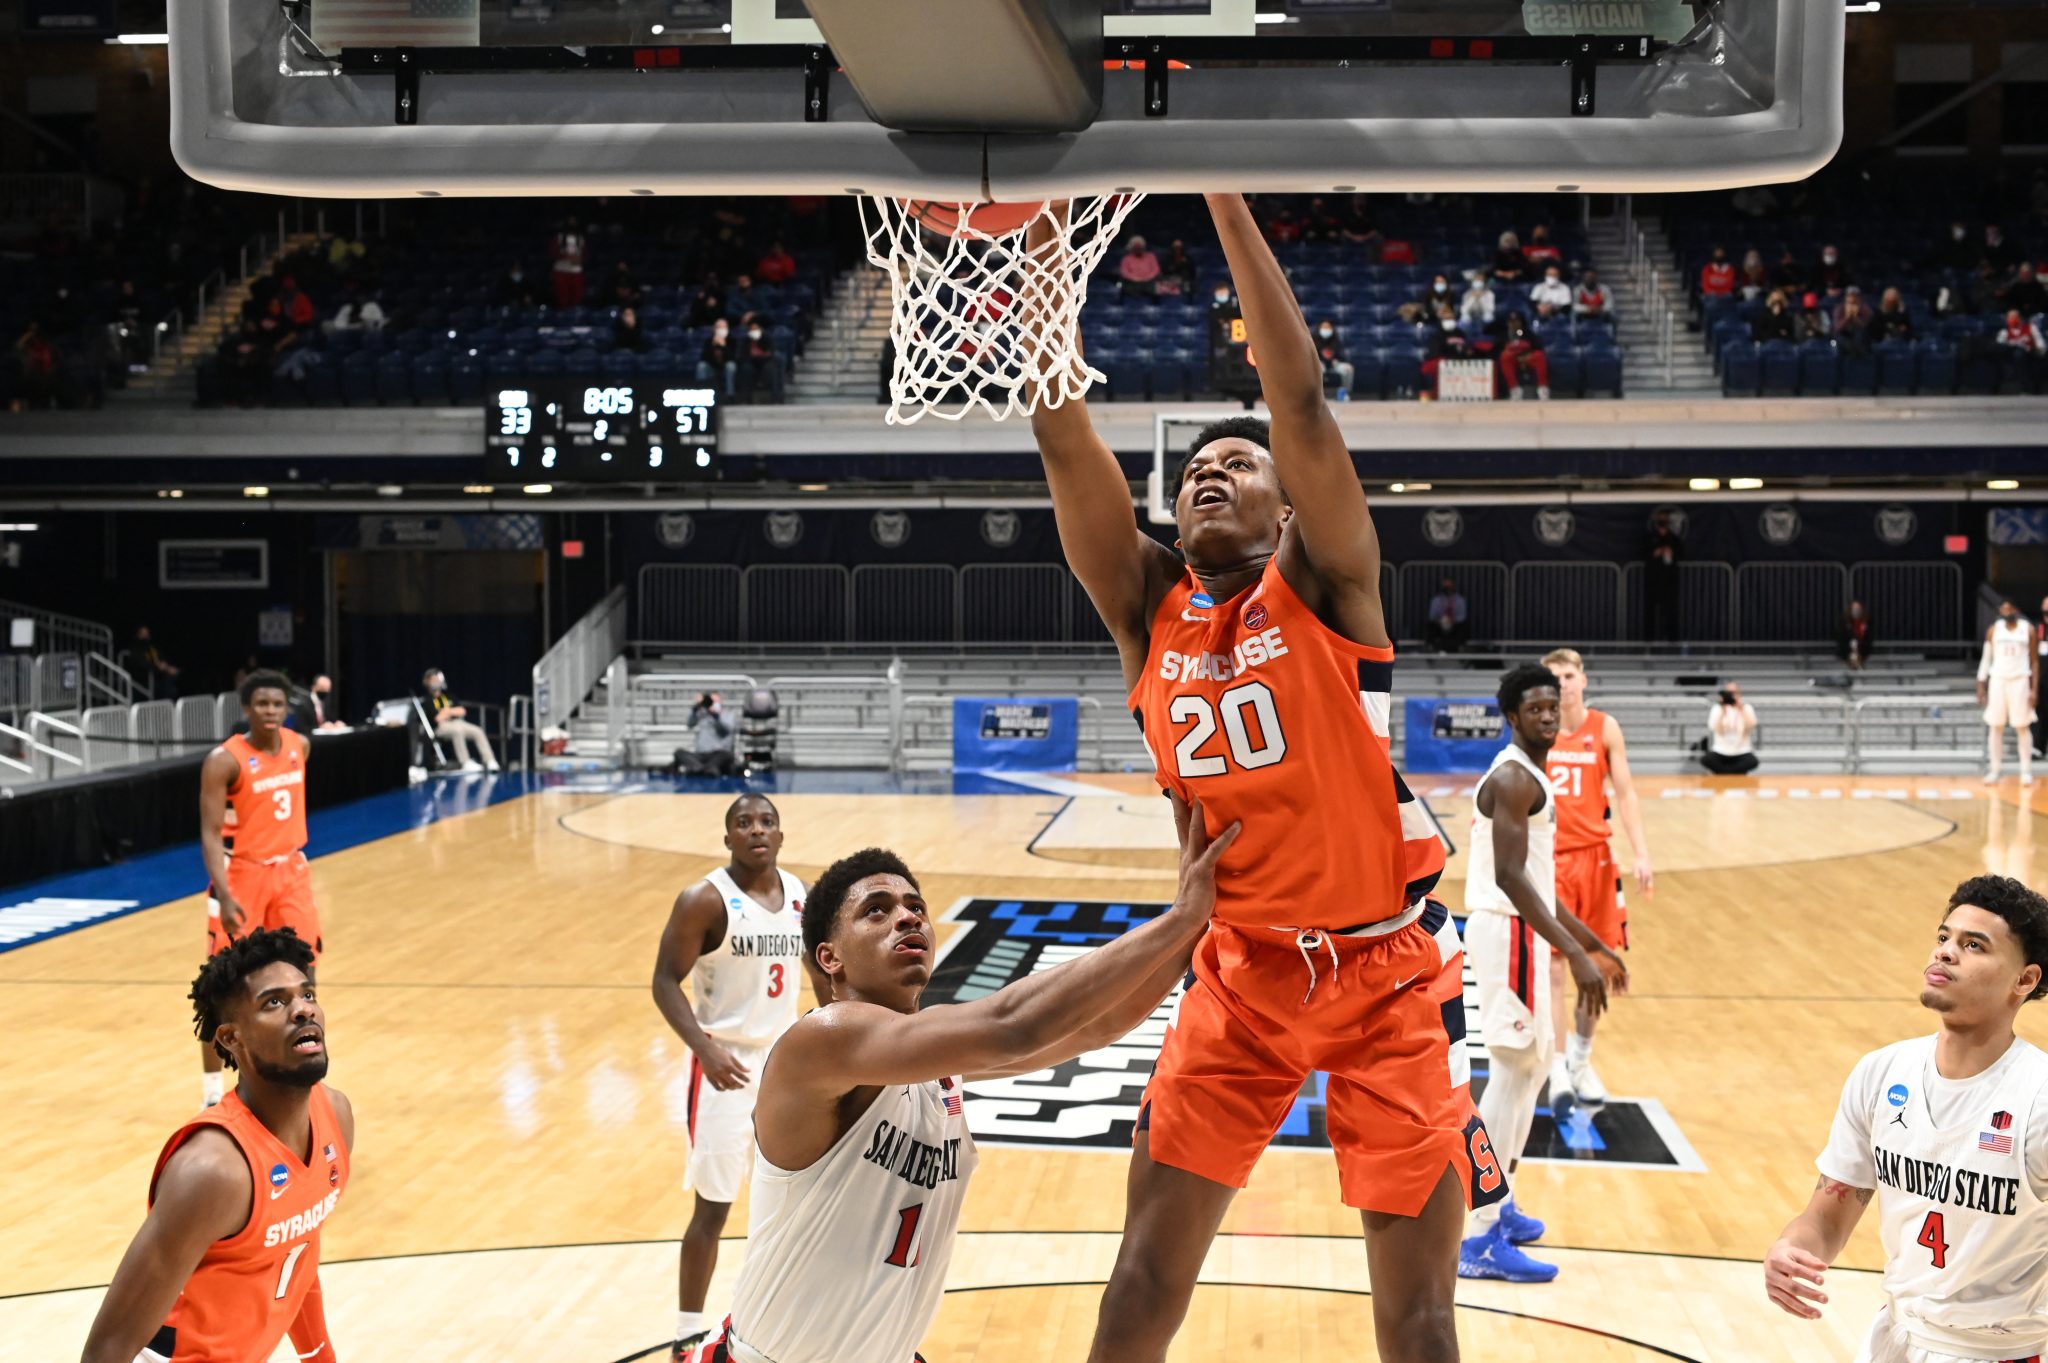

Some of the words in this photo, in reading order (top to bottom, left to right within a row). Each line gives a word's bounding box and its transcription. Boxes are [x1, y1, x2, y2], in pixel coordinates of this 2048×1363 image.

[584, 387, 633, 414] 8:05
[501, 407, 532, 434] 33
[676, 406, 708, 433] 57
[650, 446, 663, 467] 3
[1169, 680, 1288, 778] 20
[1550, 765, 1583, 797] 21
[272, 789, 292, 822] 3
[731, 935, 755, 957] SAN
[757, 934, 788, 957] DIEGO
[767, 963, 785, 998] 3
[863, 1119, 908, 1172] SAN
[1470, 1126, 1501, 1194] S
[1875, 1145, 1902, 1191] SAN
[1904, 1156, 1951, 1204] DIEGO
[1954, 1168, 2020, 1216] STATE
[1917, 1210, 1950, 1270] 4
[275, 1240, 310, 1300] 1
